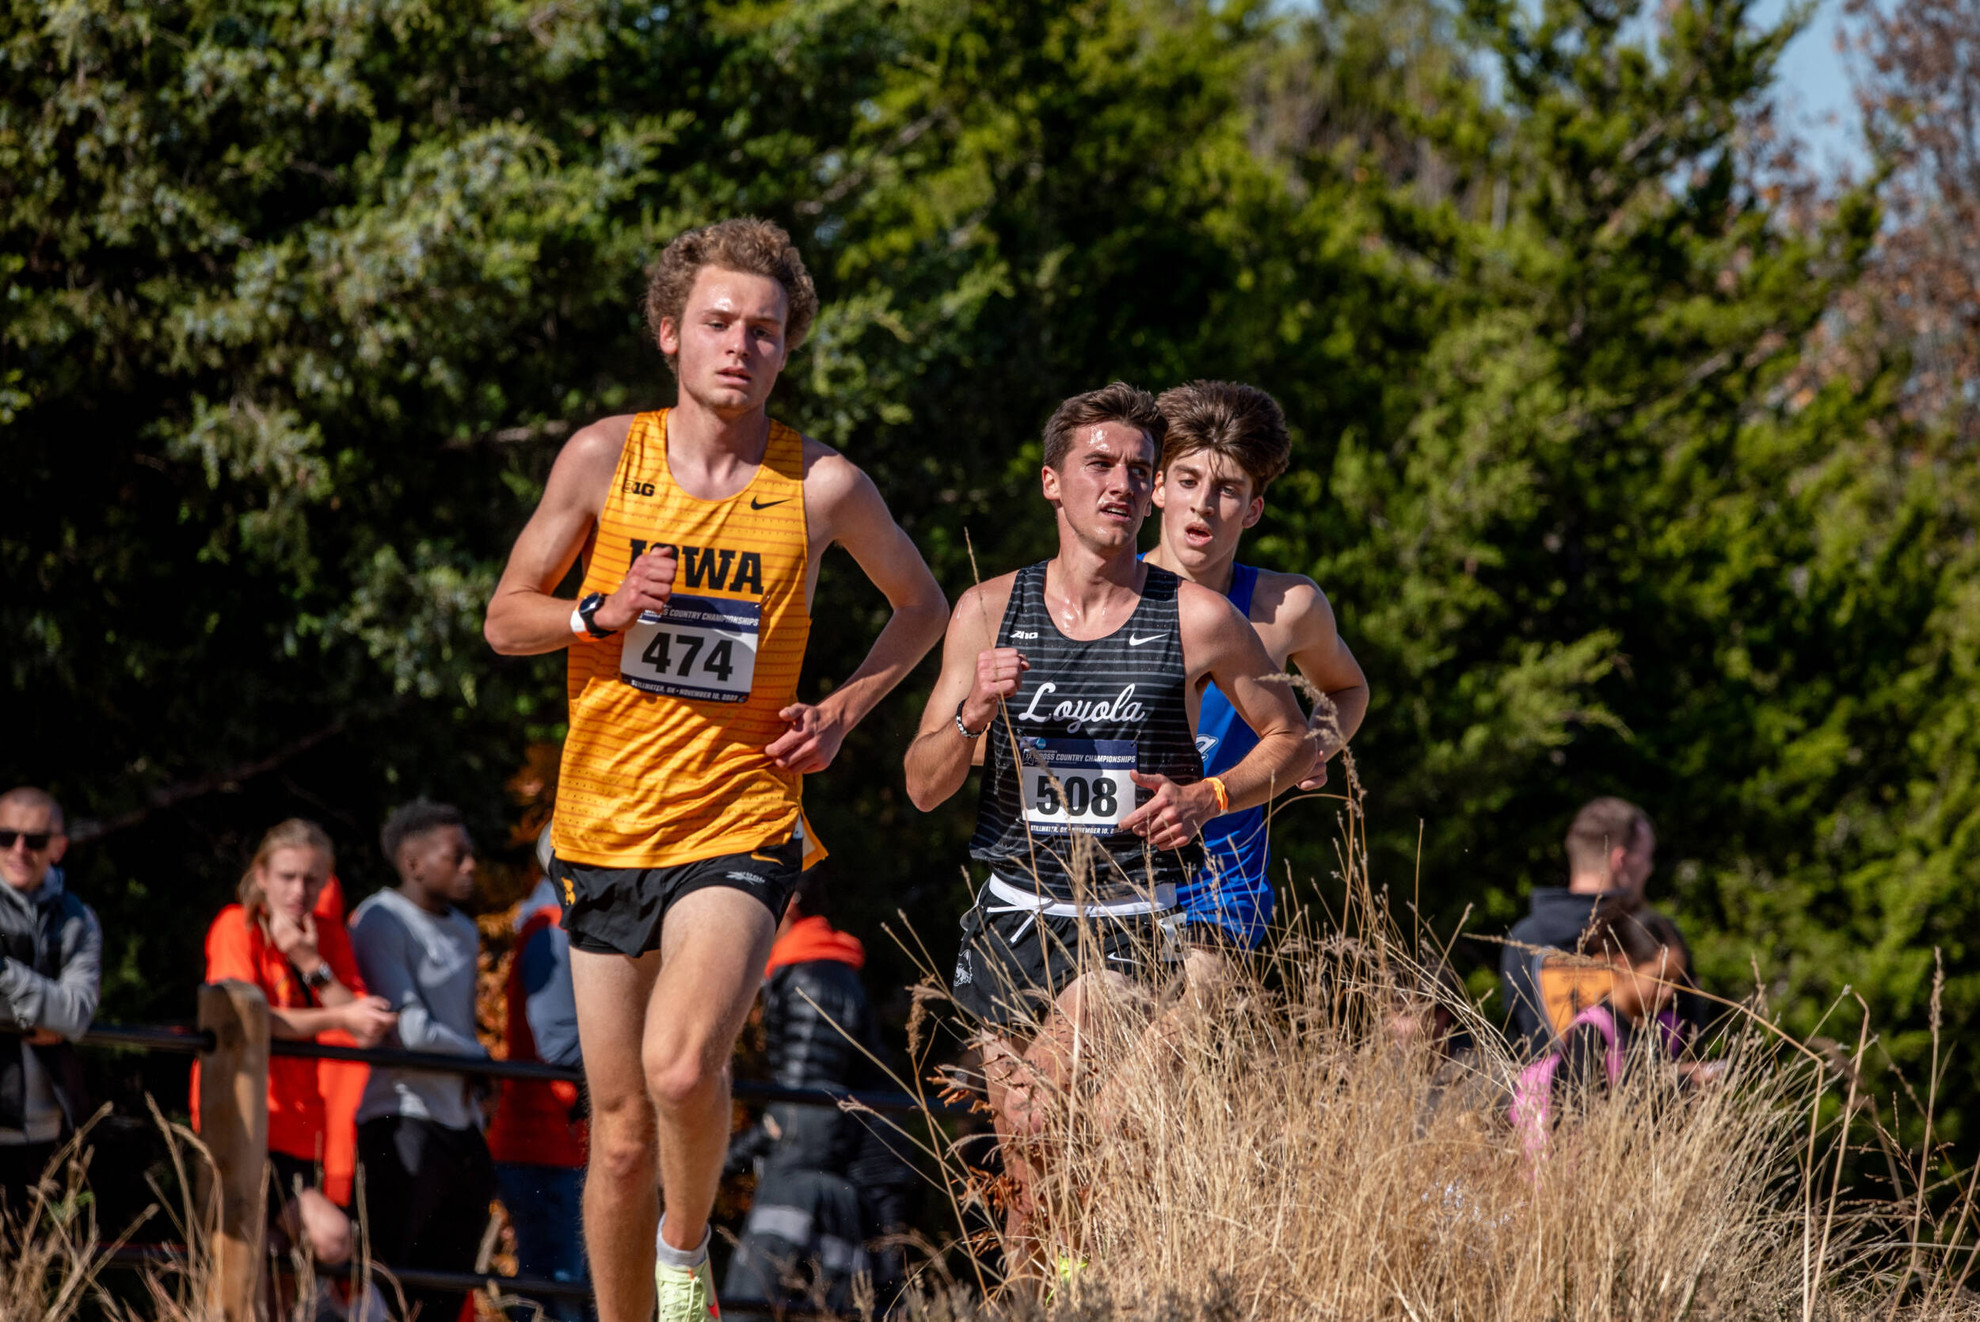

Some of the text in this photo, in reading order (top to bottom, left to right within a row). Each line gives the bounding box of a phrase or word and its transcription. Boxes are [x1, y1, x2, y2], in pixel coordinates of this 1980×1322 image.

[670, 609, 701, 619] COUNTRY
[702, 613, 759, 626] CHAMPIONSHIPS
[642, 632, 733, 682] 474
[1018, 682, 1145, 734] Loyola
[1056, 754, 1083, 762] COUNTRY
[1085, 755, 1136, 763] CHAMPIONSHIPS
[1036, 775, 1117, 818] 508
